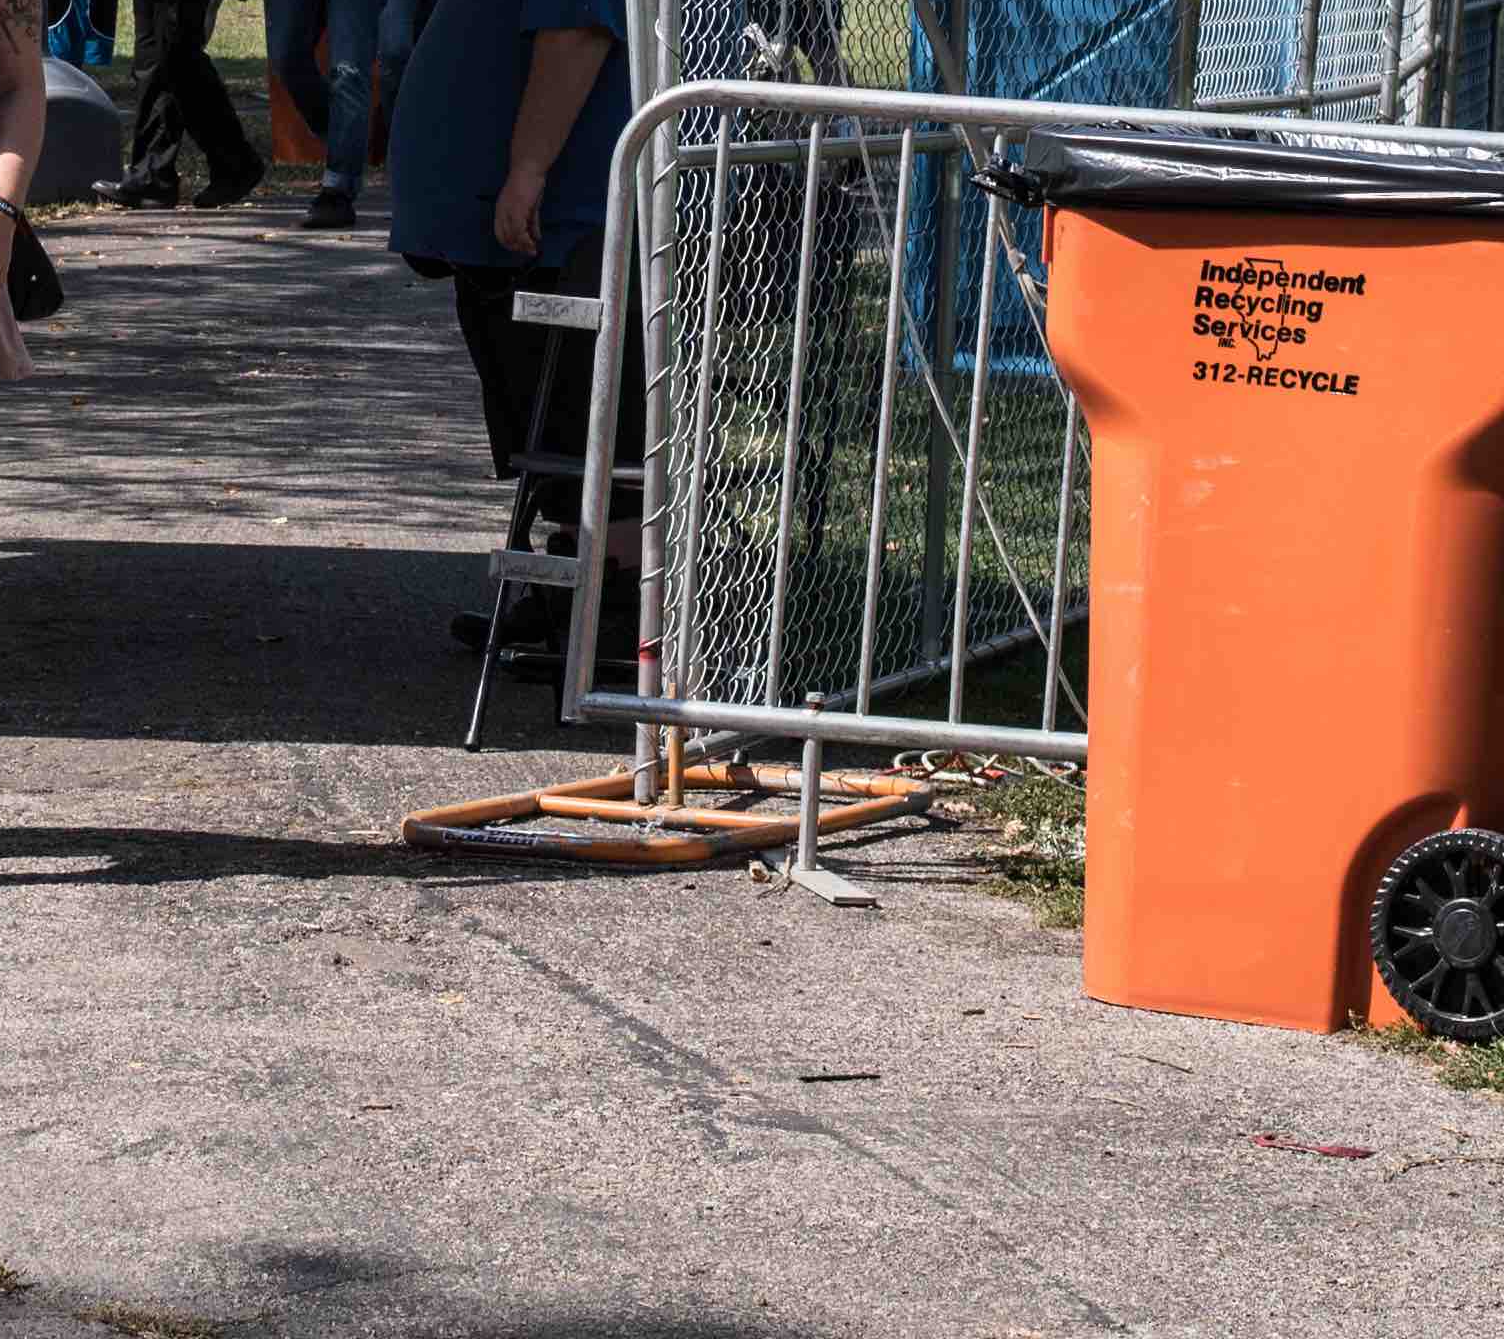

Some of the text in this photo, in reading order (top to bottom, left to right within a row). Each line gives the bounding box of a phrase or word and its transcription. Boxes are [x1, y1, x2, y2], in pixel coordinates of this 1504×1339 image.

[1200, 260, 1366, 295] Independent
[1194, 286, 1324, 322] Recycling
[1192, 313, 1307, 344] Services
[1192, 361, 1361, 396] 312-RECYCLE
